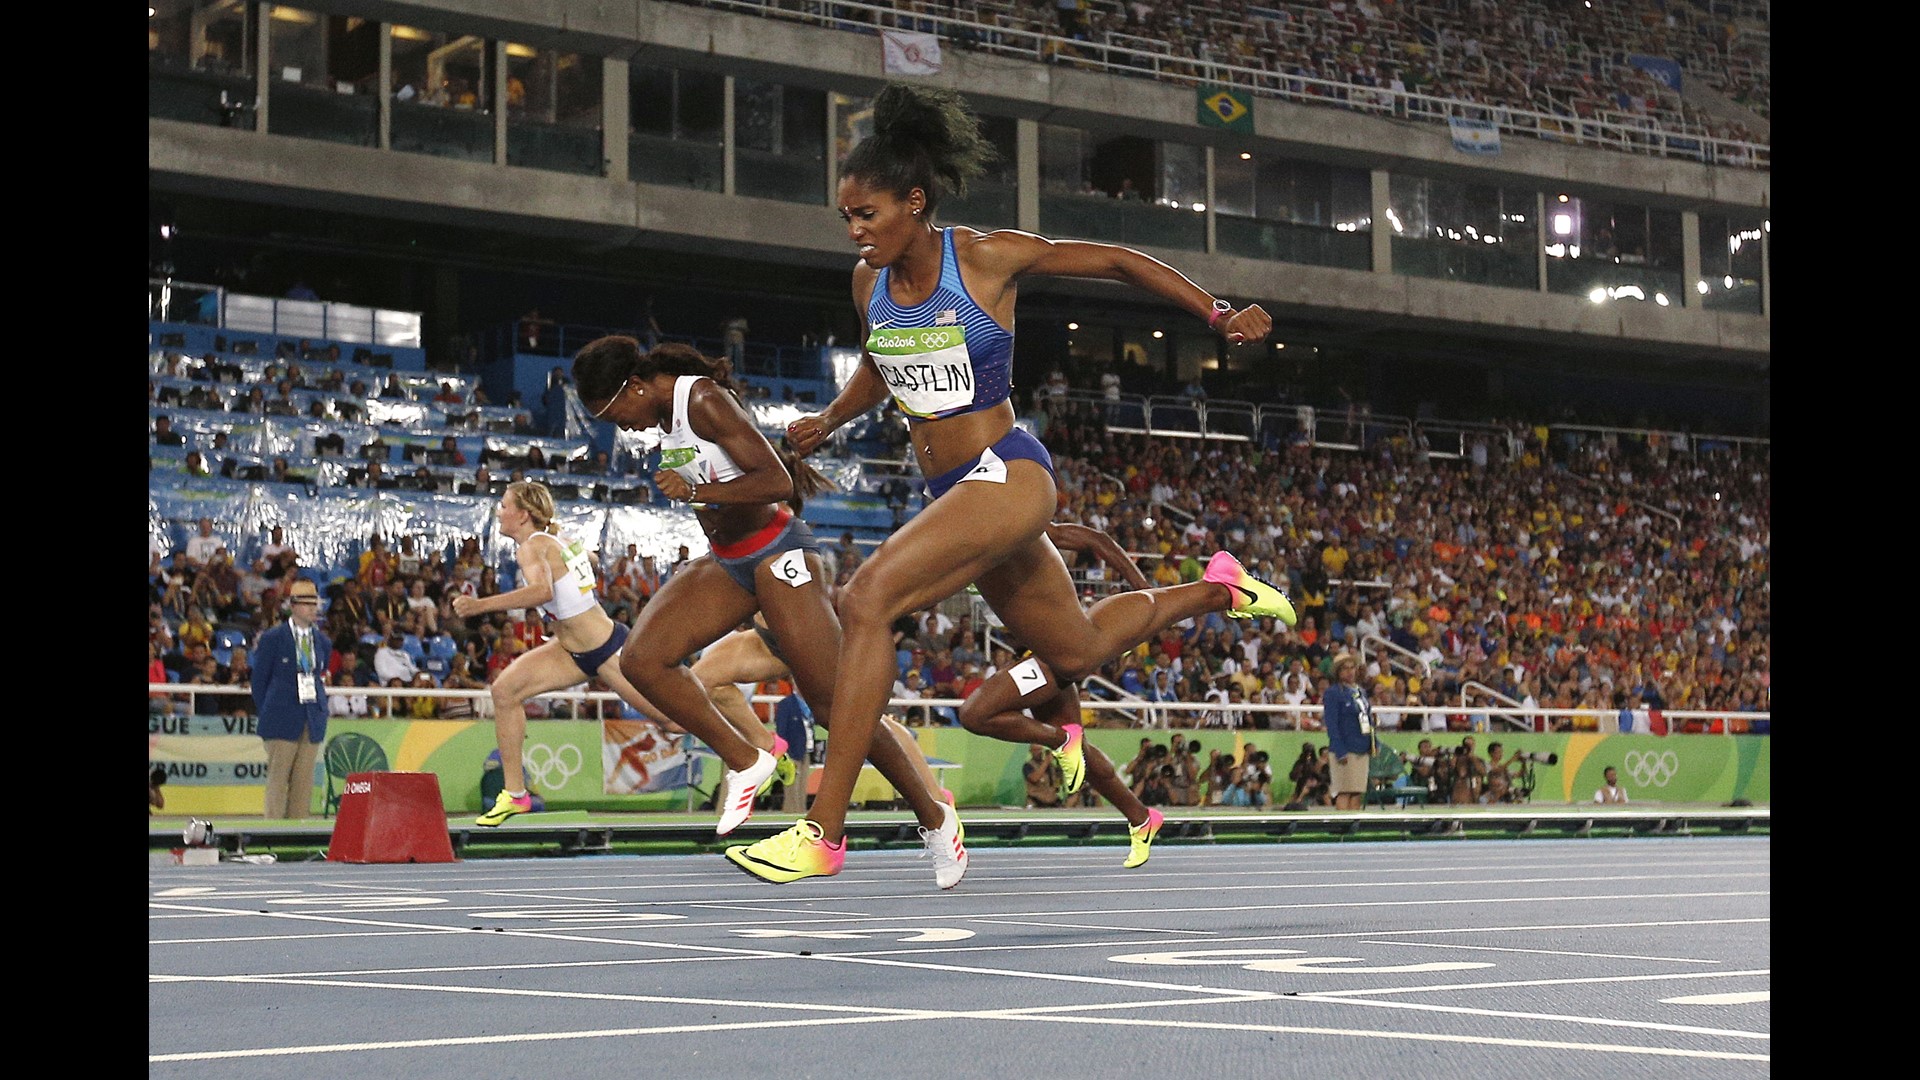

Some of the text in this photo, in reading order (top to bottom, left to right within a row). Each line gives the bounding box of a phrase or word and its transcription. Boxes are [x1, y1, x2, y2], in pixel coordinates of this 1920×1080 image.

[877, 336, 916, 348] Rio2016
[879, 362, 971, 391] CASTLIN
[783, 559, 799, 579] 6
[1022, 669, 1038, 680] 7
[1107, 948, 1498, 973] 3
